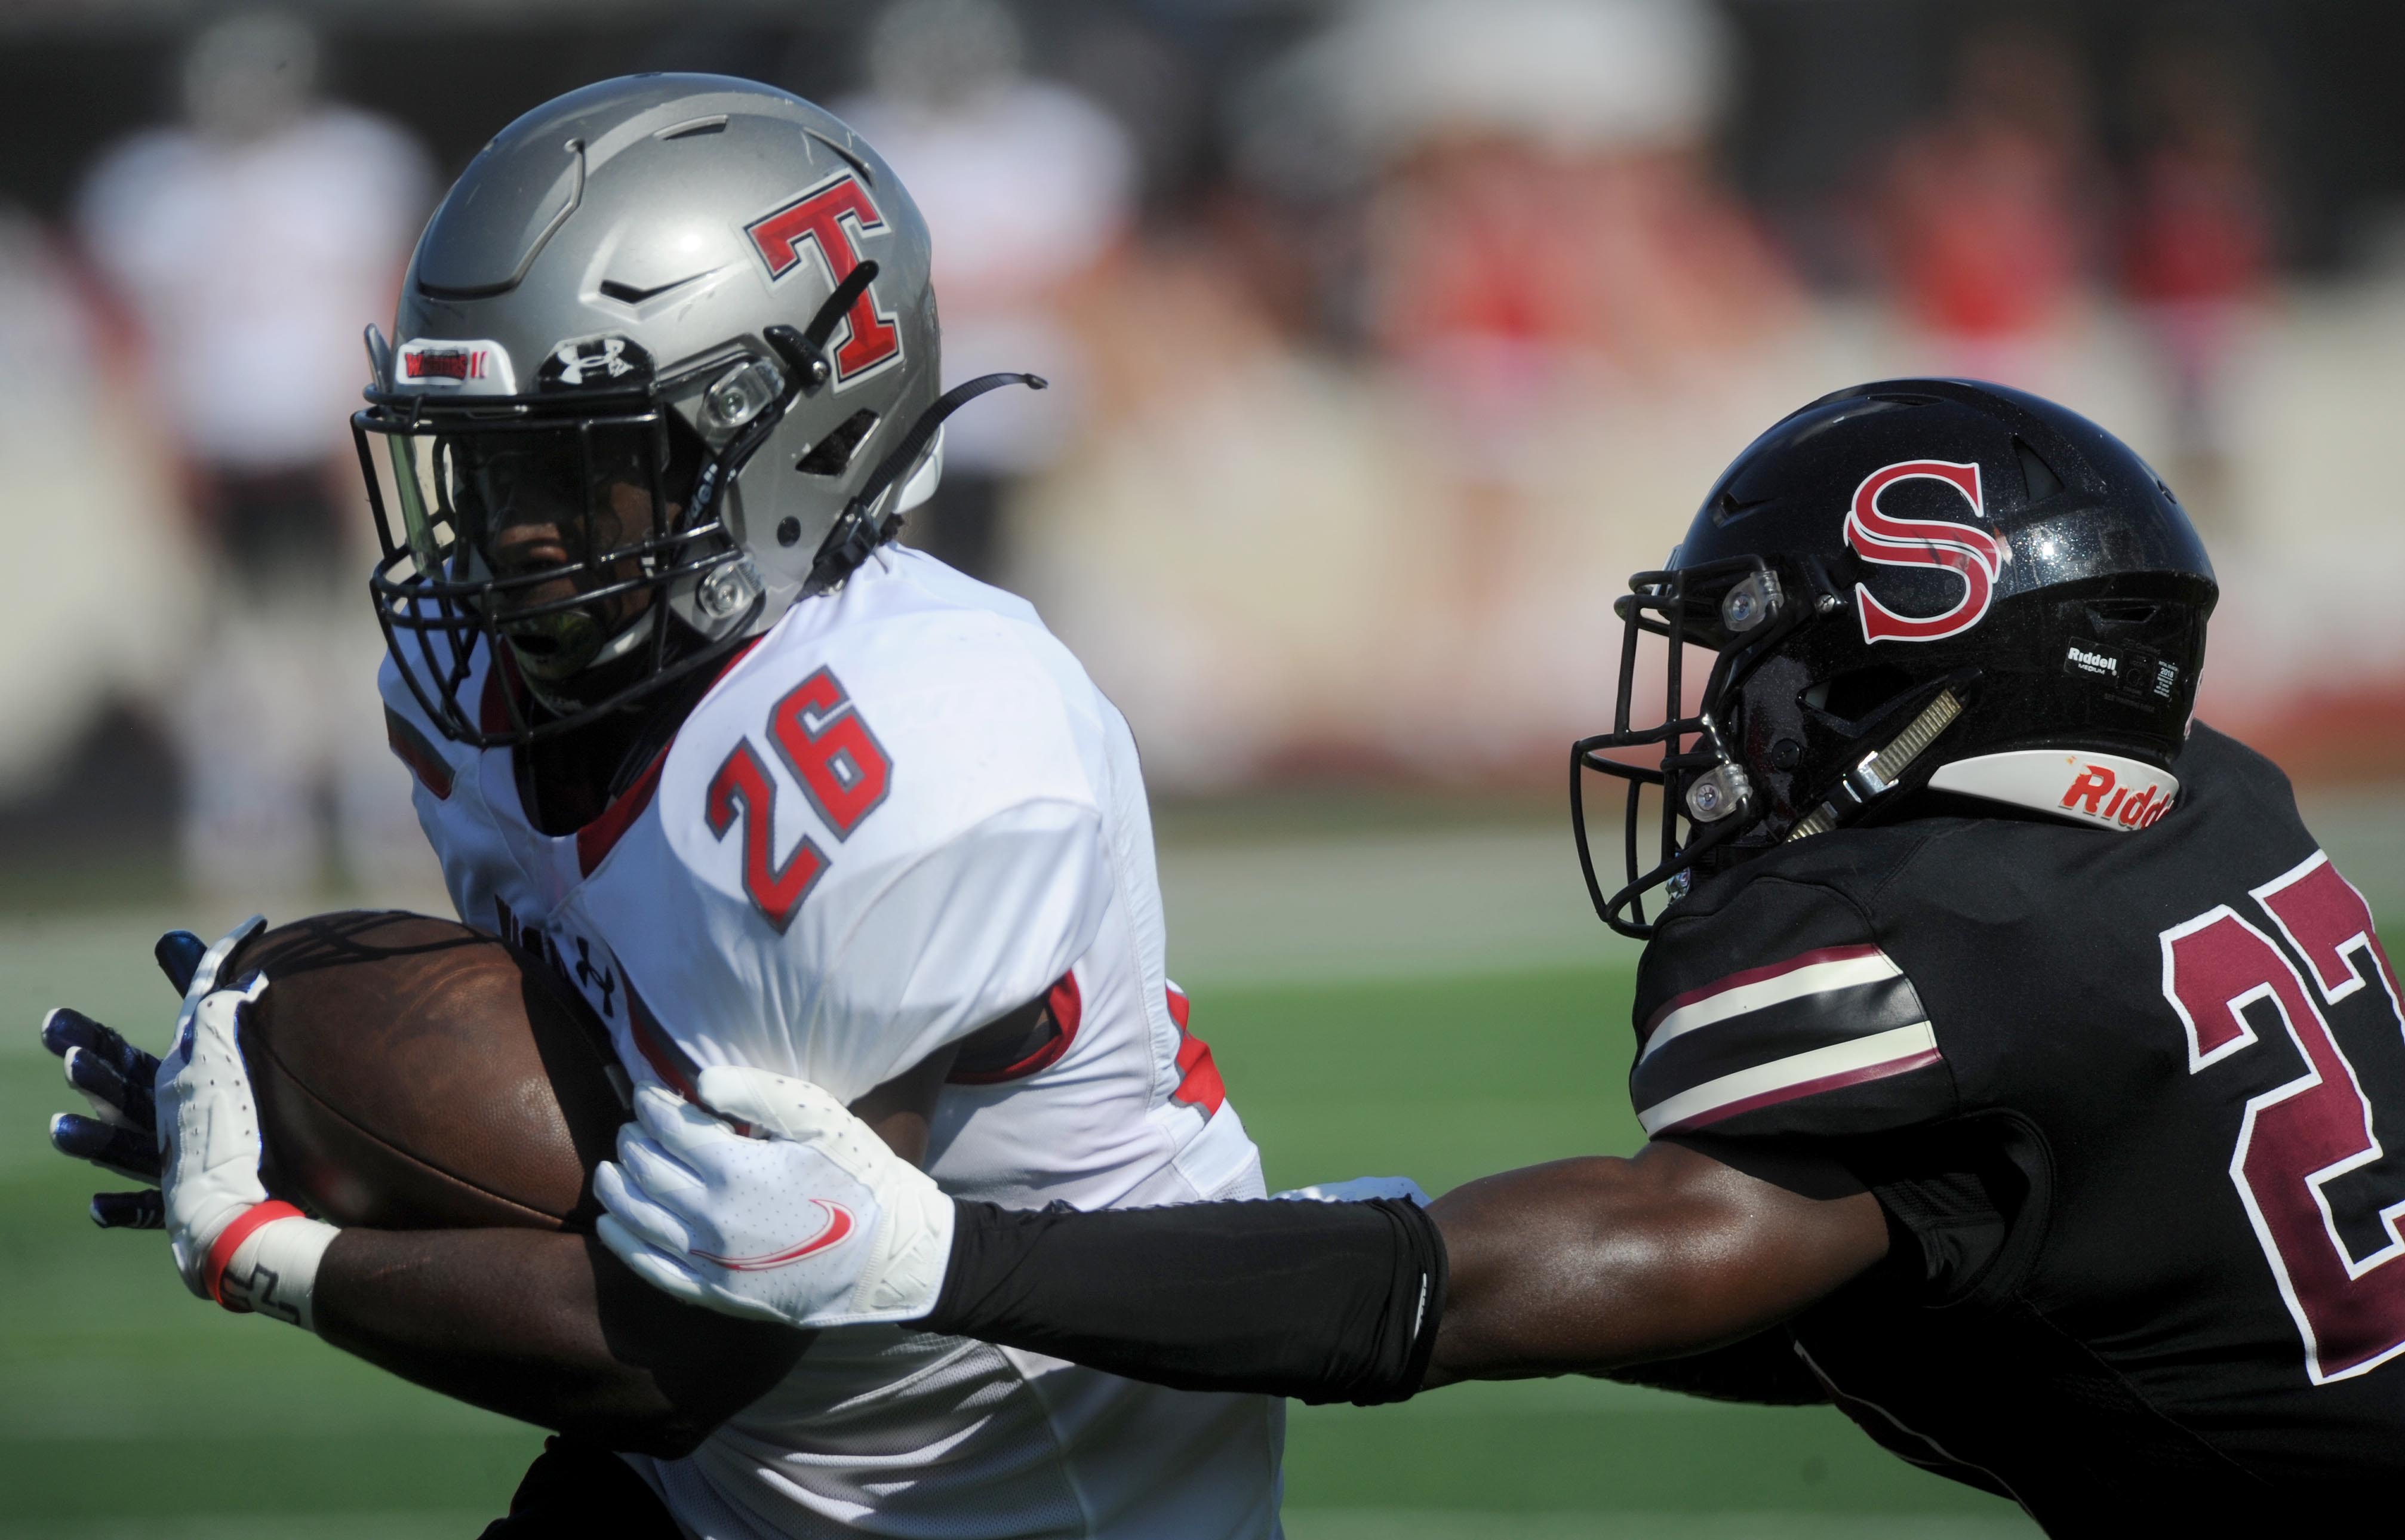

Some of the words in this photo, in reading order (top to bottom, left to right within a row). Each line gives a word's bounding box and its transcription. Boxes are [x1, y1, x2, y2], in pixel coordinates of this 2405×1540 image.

[736, 168, 904, 394] T
[1843, 459, 2002, 645] S
[2068, 647, 2117, 670] Riddell
[705, 662, 894, 936] 26
[2058, 764, 2174, 830] Ridd
